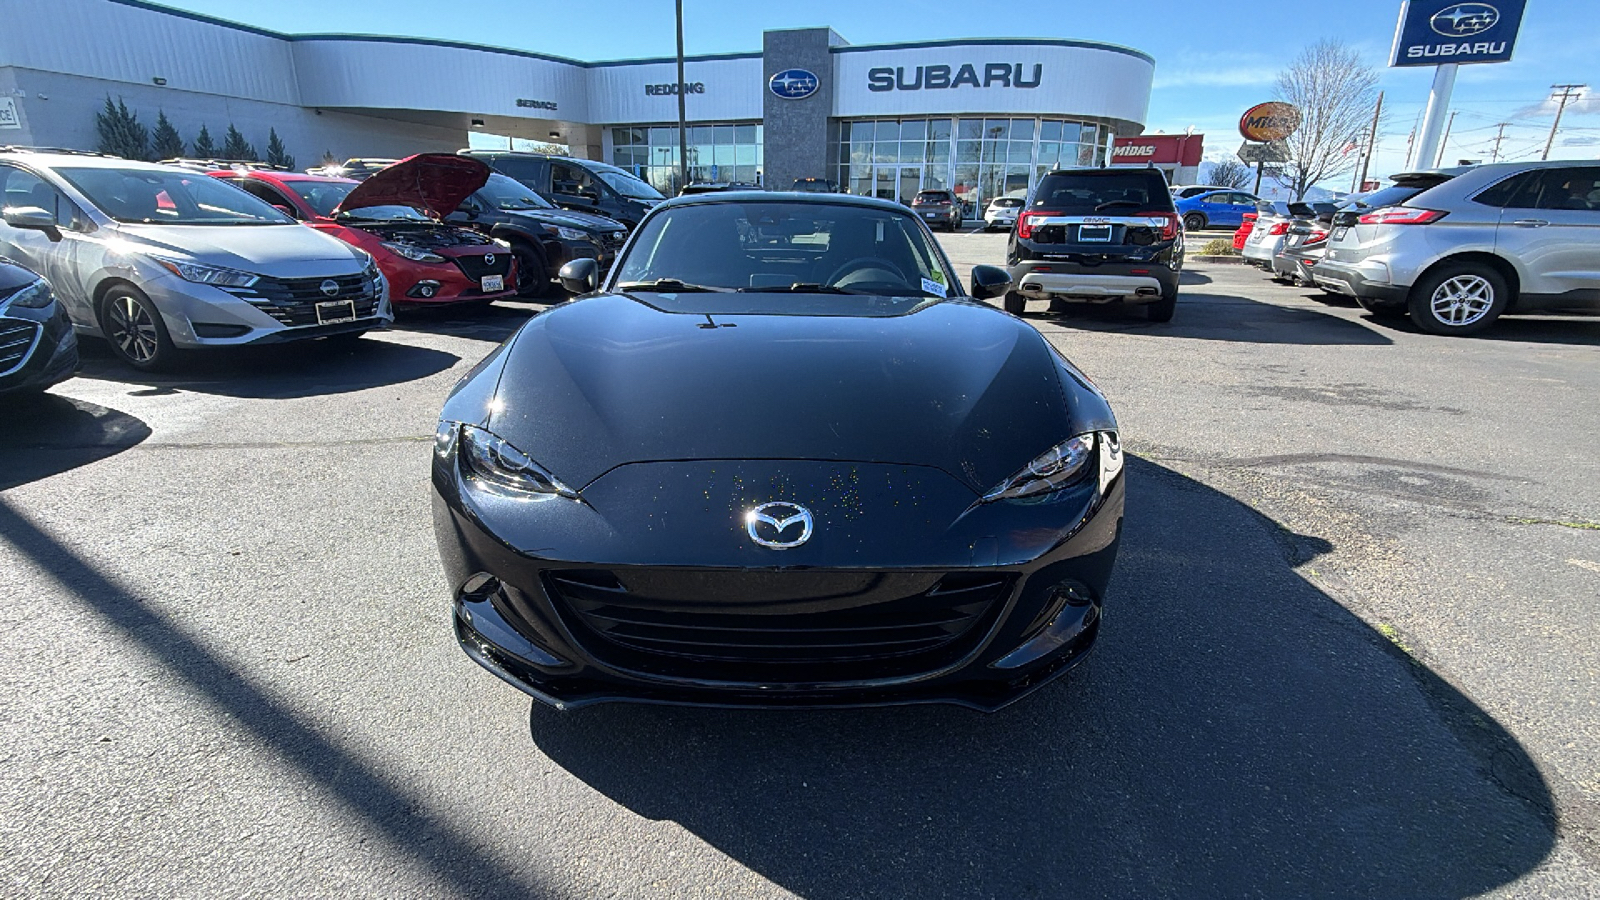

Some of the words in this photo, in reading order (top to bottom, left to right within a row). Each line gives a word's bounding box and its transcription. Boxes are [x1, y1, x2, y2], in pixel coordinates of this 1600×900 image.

[1407, 41, 1506, 58] SUBARU
[868, 63, 1042, 92] SUBARU
[645, 82, 705, 96] REDDNG
